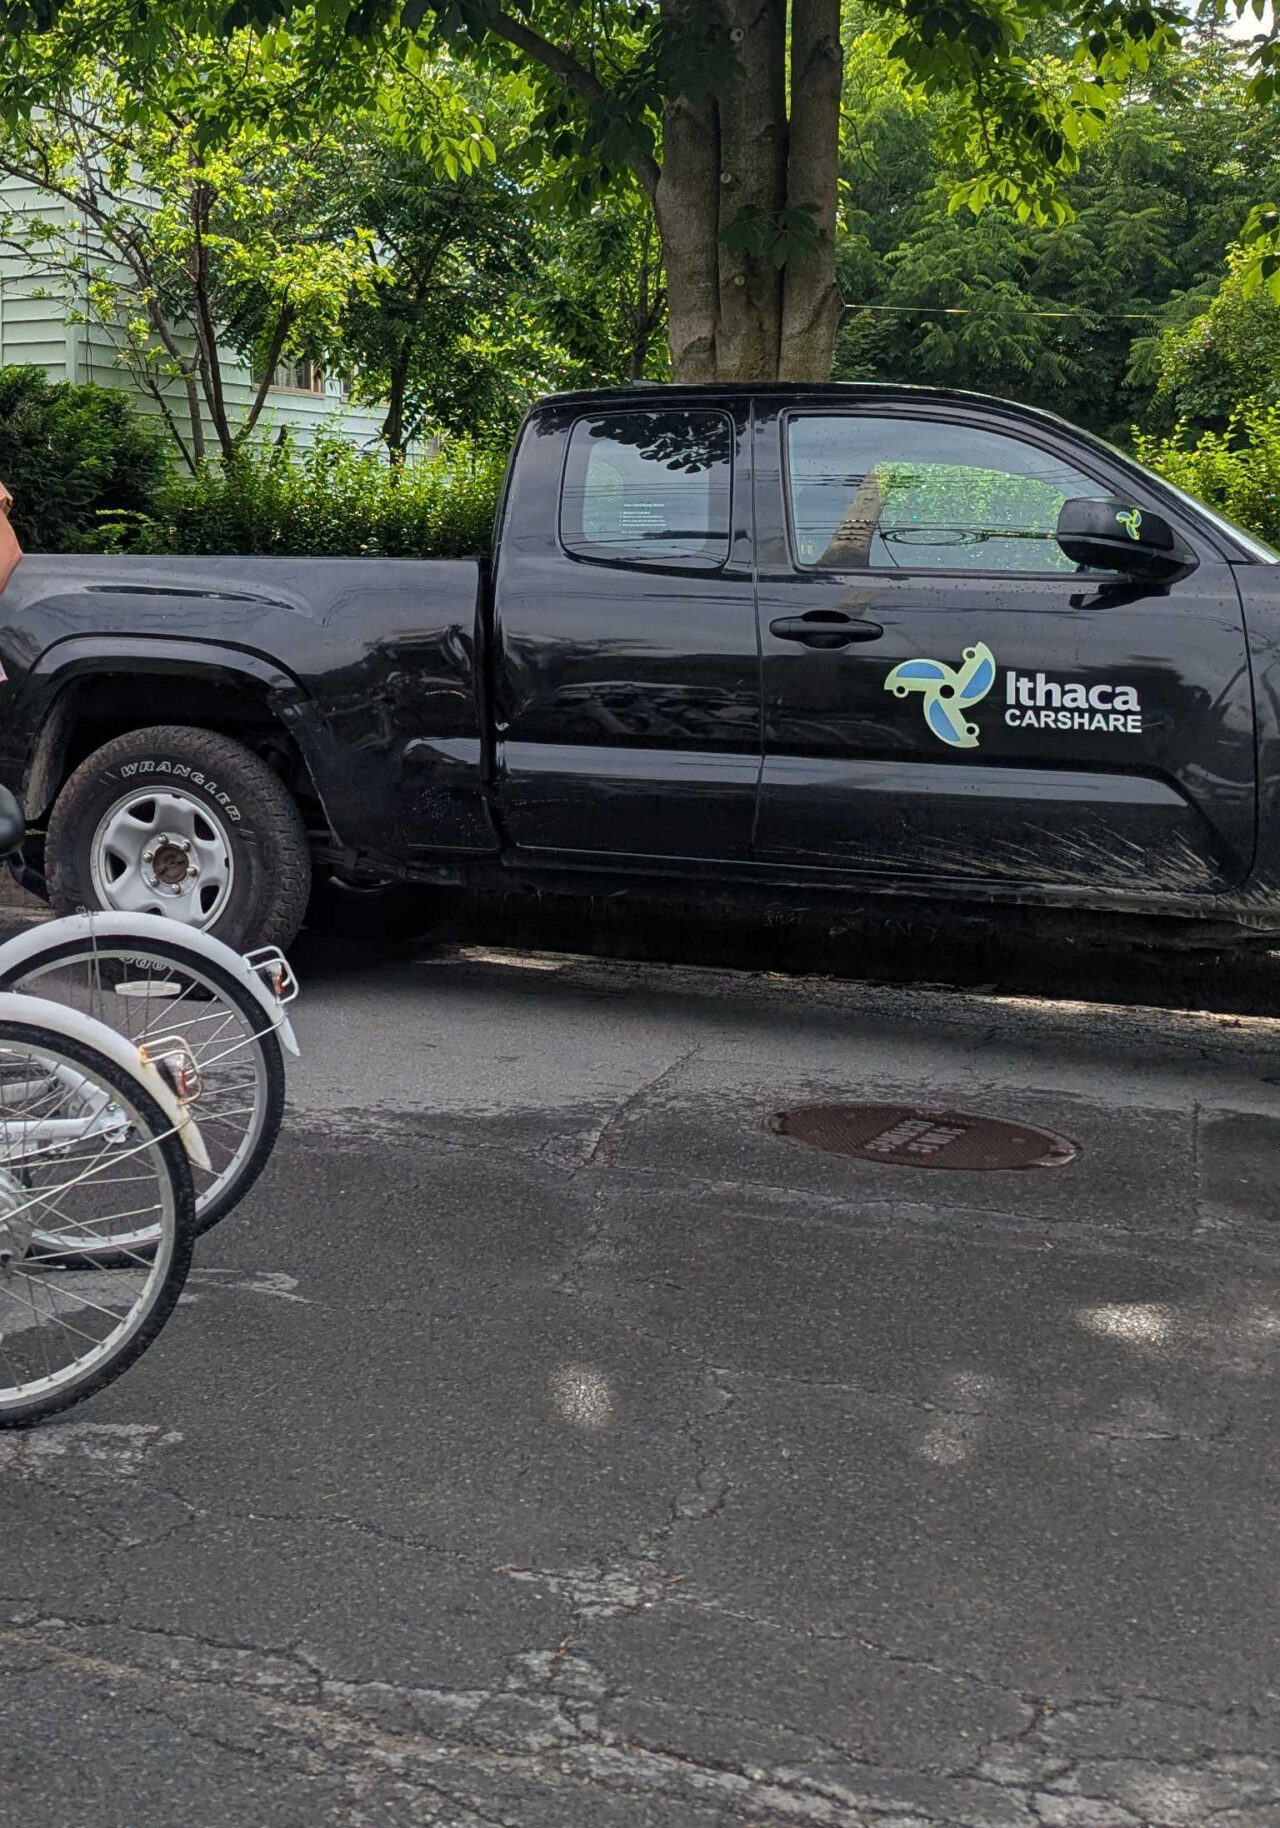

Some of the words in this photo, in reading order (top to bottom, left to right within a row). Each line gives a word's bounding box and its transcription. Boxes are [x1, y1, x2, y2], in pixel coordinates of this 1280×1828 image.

[1006, 671, 1141, 712] Ithaca
[1004, 708, 1143, 734] CARSHARE
[120, 760, 243, 823] WRANGLER
